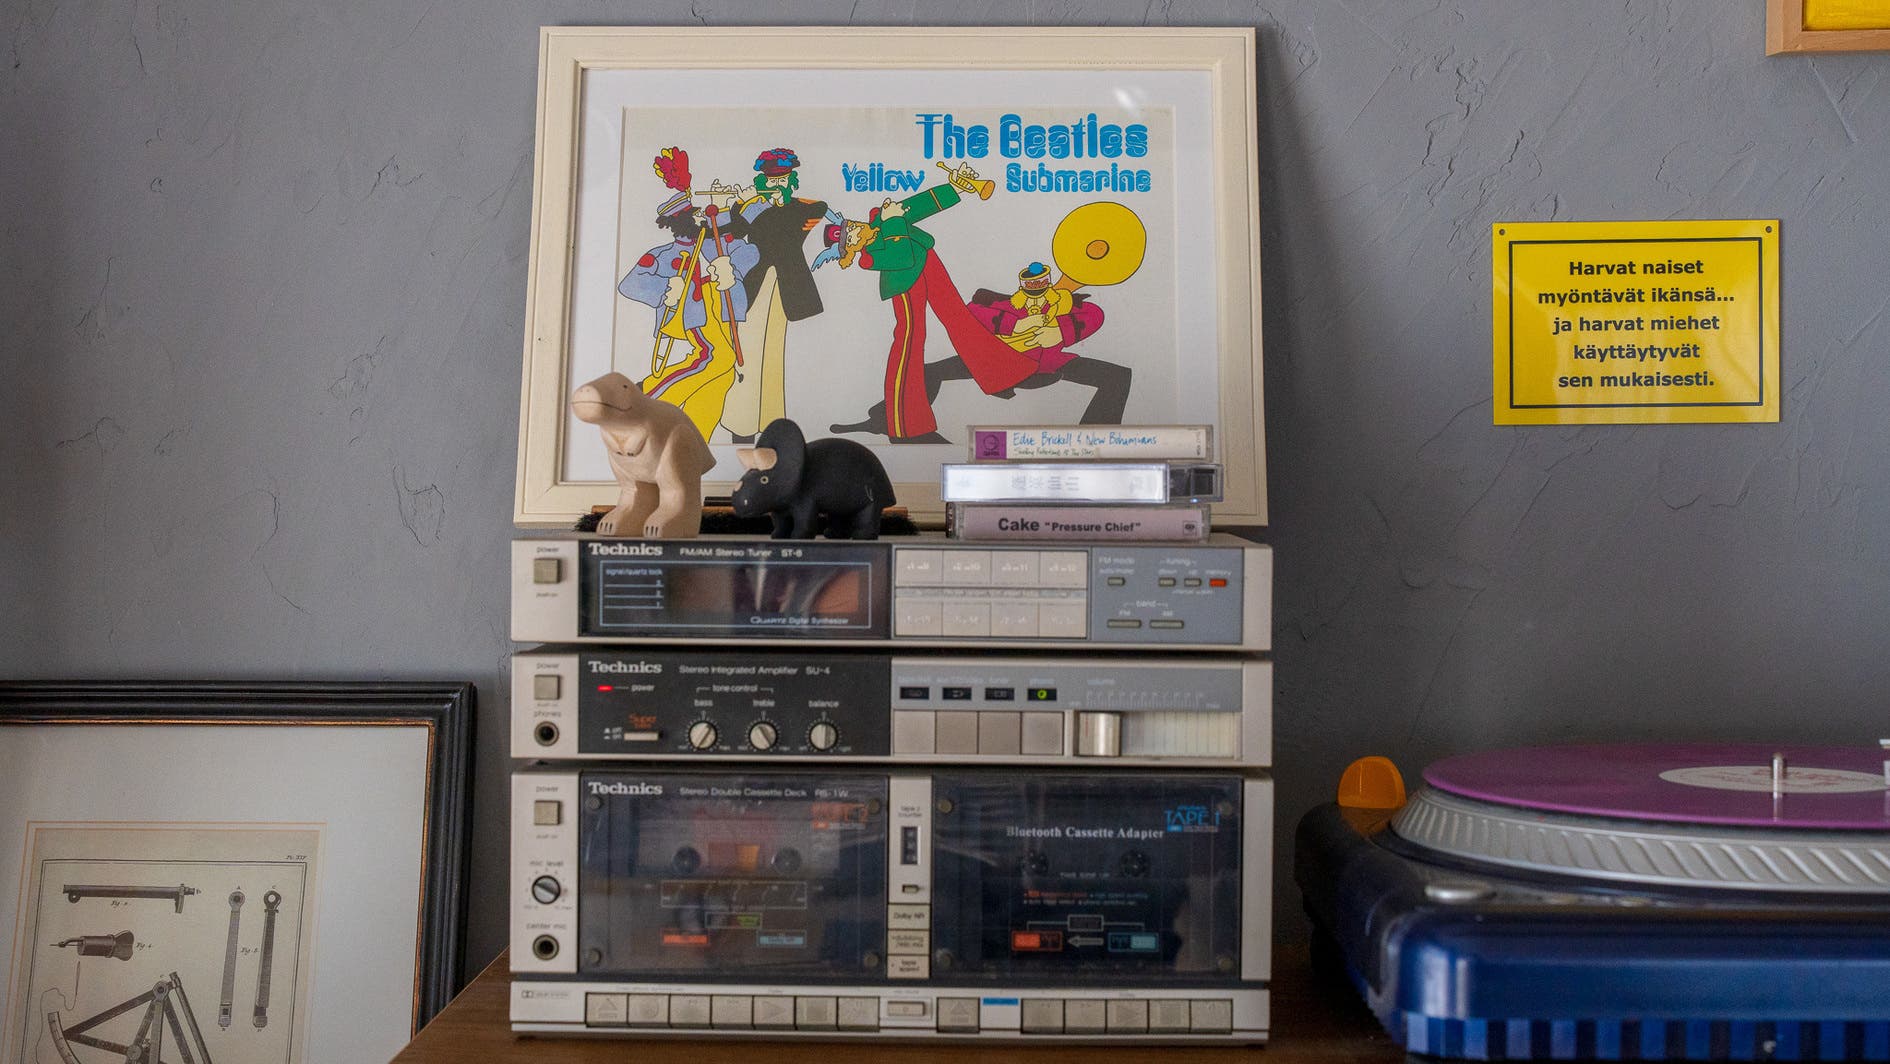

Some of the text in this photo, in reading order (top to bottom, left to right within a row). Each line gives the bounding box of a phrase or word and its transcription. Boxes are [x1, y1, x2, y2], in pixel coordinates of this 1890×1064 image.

[915, 113, 1148, 159] The Beatles
[841, 162, 1151, 193] Yellow Submarine
[1569, 260, 1704, 275] Harvat naiset
[1538, 287, 1735, 307] myöntävät ikänsä...
[1552, 315, 1720, 335] ja harvat miehet
[1573, 344, 1700, 362] käyttäytyvät
[1558, 371, 1714, 387] sen mukaisesti.
[1013, 431, 1035, 446] Edie
[1041, 431, 1072, 446] Brickell
[1086, 432, 1105, 446] New
[998, 518, 1040, 532] Cake
[588, 542, 663, 556] Technics
[680, 548, 713, 556] FM/AM
[715, 548, 744, 557] Stereo
[749, 548, 772, 557] Tuner
[588, 661, 663, 673] Technics
[679, 665, 709, 674] Stereo
[711, 665, 755, 675] Integrated
[758, 665, 798, 675] Amplifier
[631, 685, 655, 693] power
[712, 684, 758, 692] tone control
[694, 699, 713, 707] bass
[753, 699, 775, 707] treble
[808, 700, 839, 708] balance
[588, 782, 663, 795] Technics
[679, 787, 708, 796] Stereo
[711, 787, 741, 796] Double
[744, 788, 782, 797] Cassette
[784, 788, 807, 797] Deck
[1164, 807, 1208, 826] TAPE
[1006, 825, 1061, 837] Bluetooth
[1065, 826, 1113, 838] Cassette
[1117, 828, 1164, 840] Adapter
